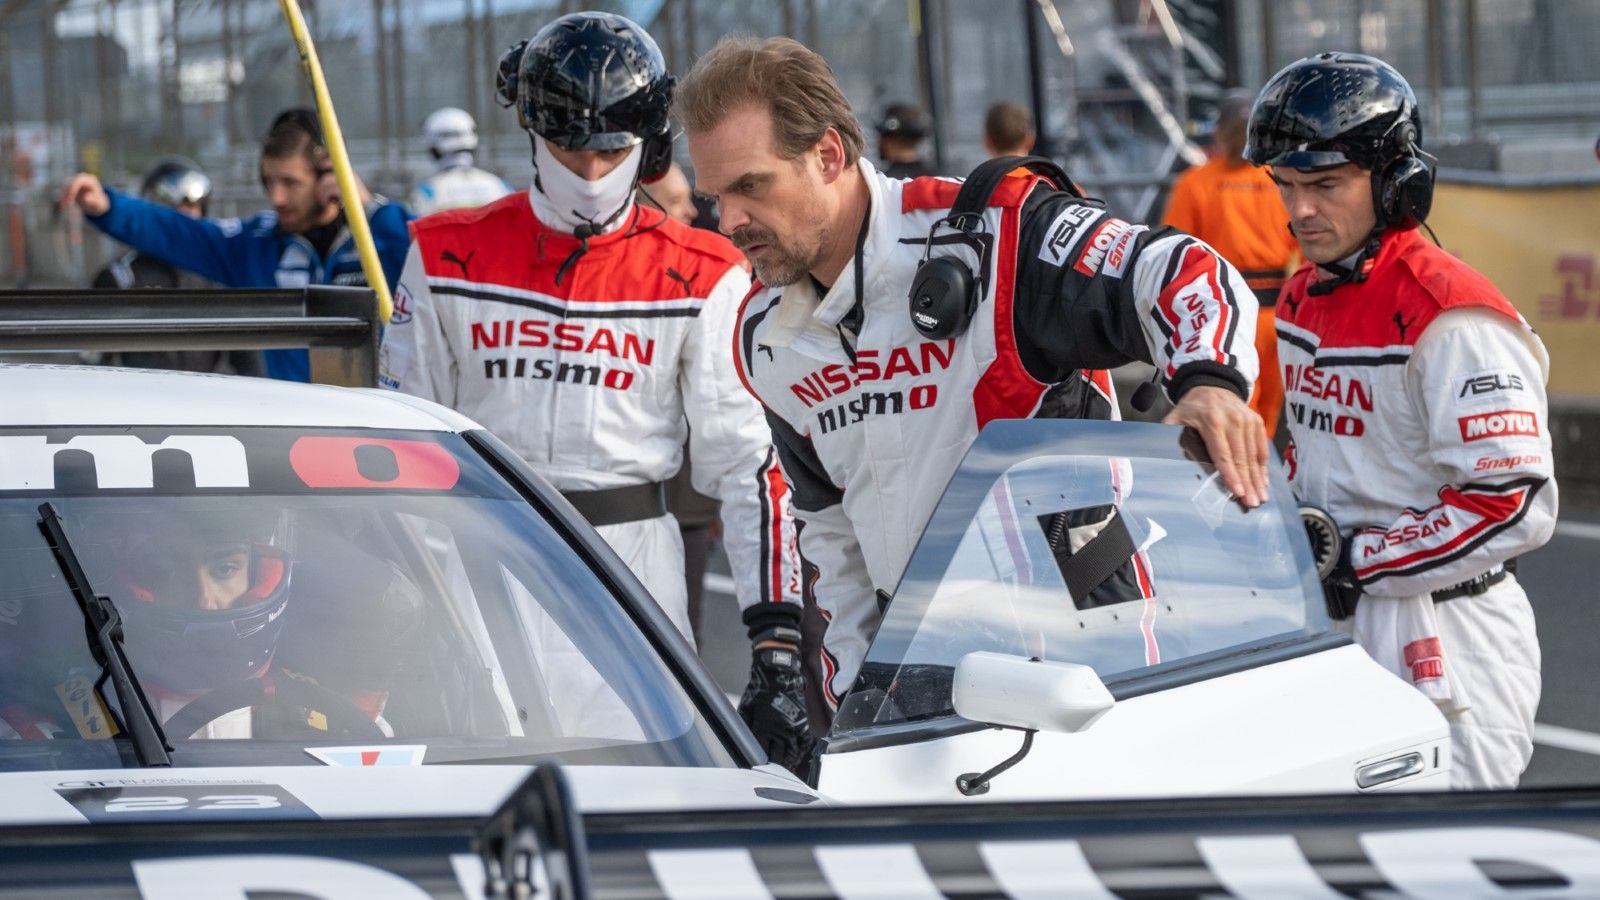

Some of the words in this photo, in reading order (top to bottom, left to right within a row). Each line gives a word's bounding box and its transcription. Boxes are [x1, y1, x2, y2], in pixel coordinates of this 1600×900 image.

[1047, 206, 1095, 262] ASUS
[1082, 218, 1131, 273] MOTU
[471, 320, 655, 366] NISSAN
[484, 357, 634, 391] nismo
[790, 338, 956, 408] NISSAN
[1459, 373, 1524, 398] ASUS
[1466, 413, 1537, 439] MOTUL
[1474, 455, 1542, 472] Snap-on
[1363, 512, 1452, 558] NISSAN
